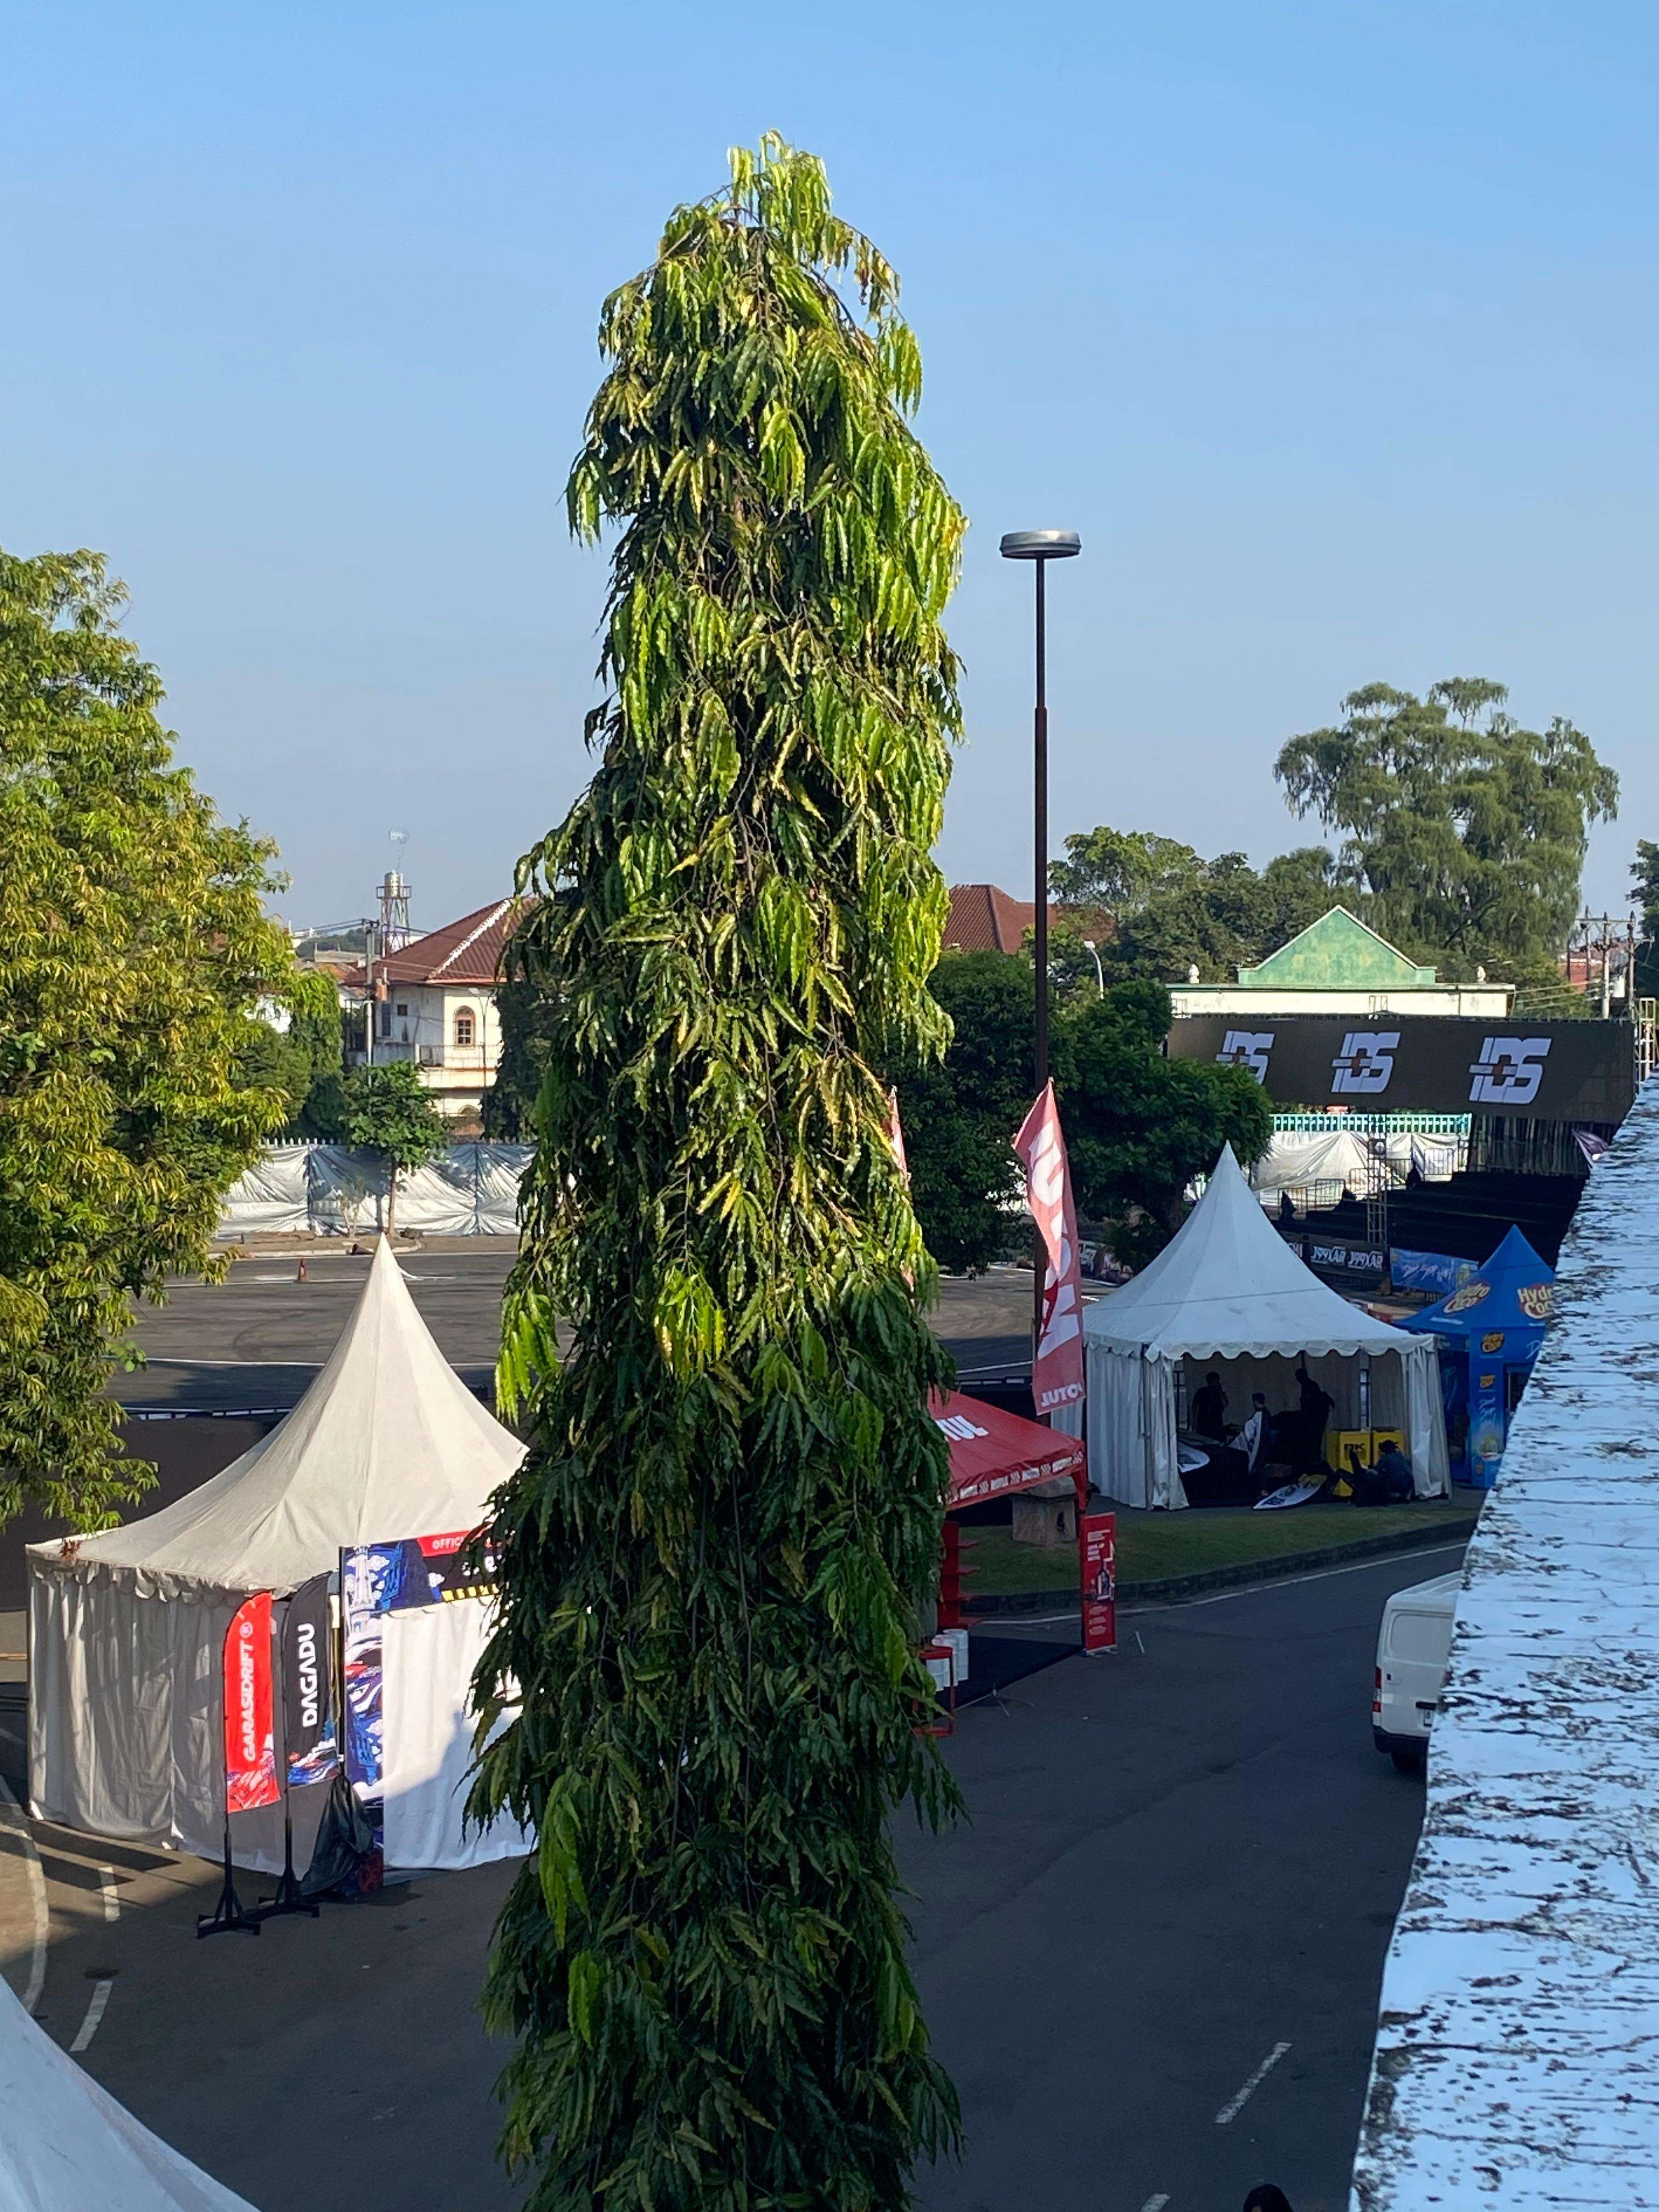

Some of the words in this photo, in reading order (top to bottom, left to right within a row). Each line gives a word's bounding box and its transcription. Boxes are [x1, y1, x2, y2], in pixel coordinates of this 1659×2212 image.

[1517, 1285, 1552, 1304] Hydr
[1524, 1300, 1554, 1319] Coc
[432, 1536, 466, 1550] OFFIC
[298, 1622, 318, 1728] DAGADU
[239, 1640, 256, 1762] GARASIDRIFT
